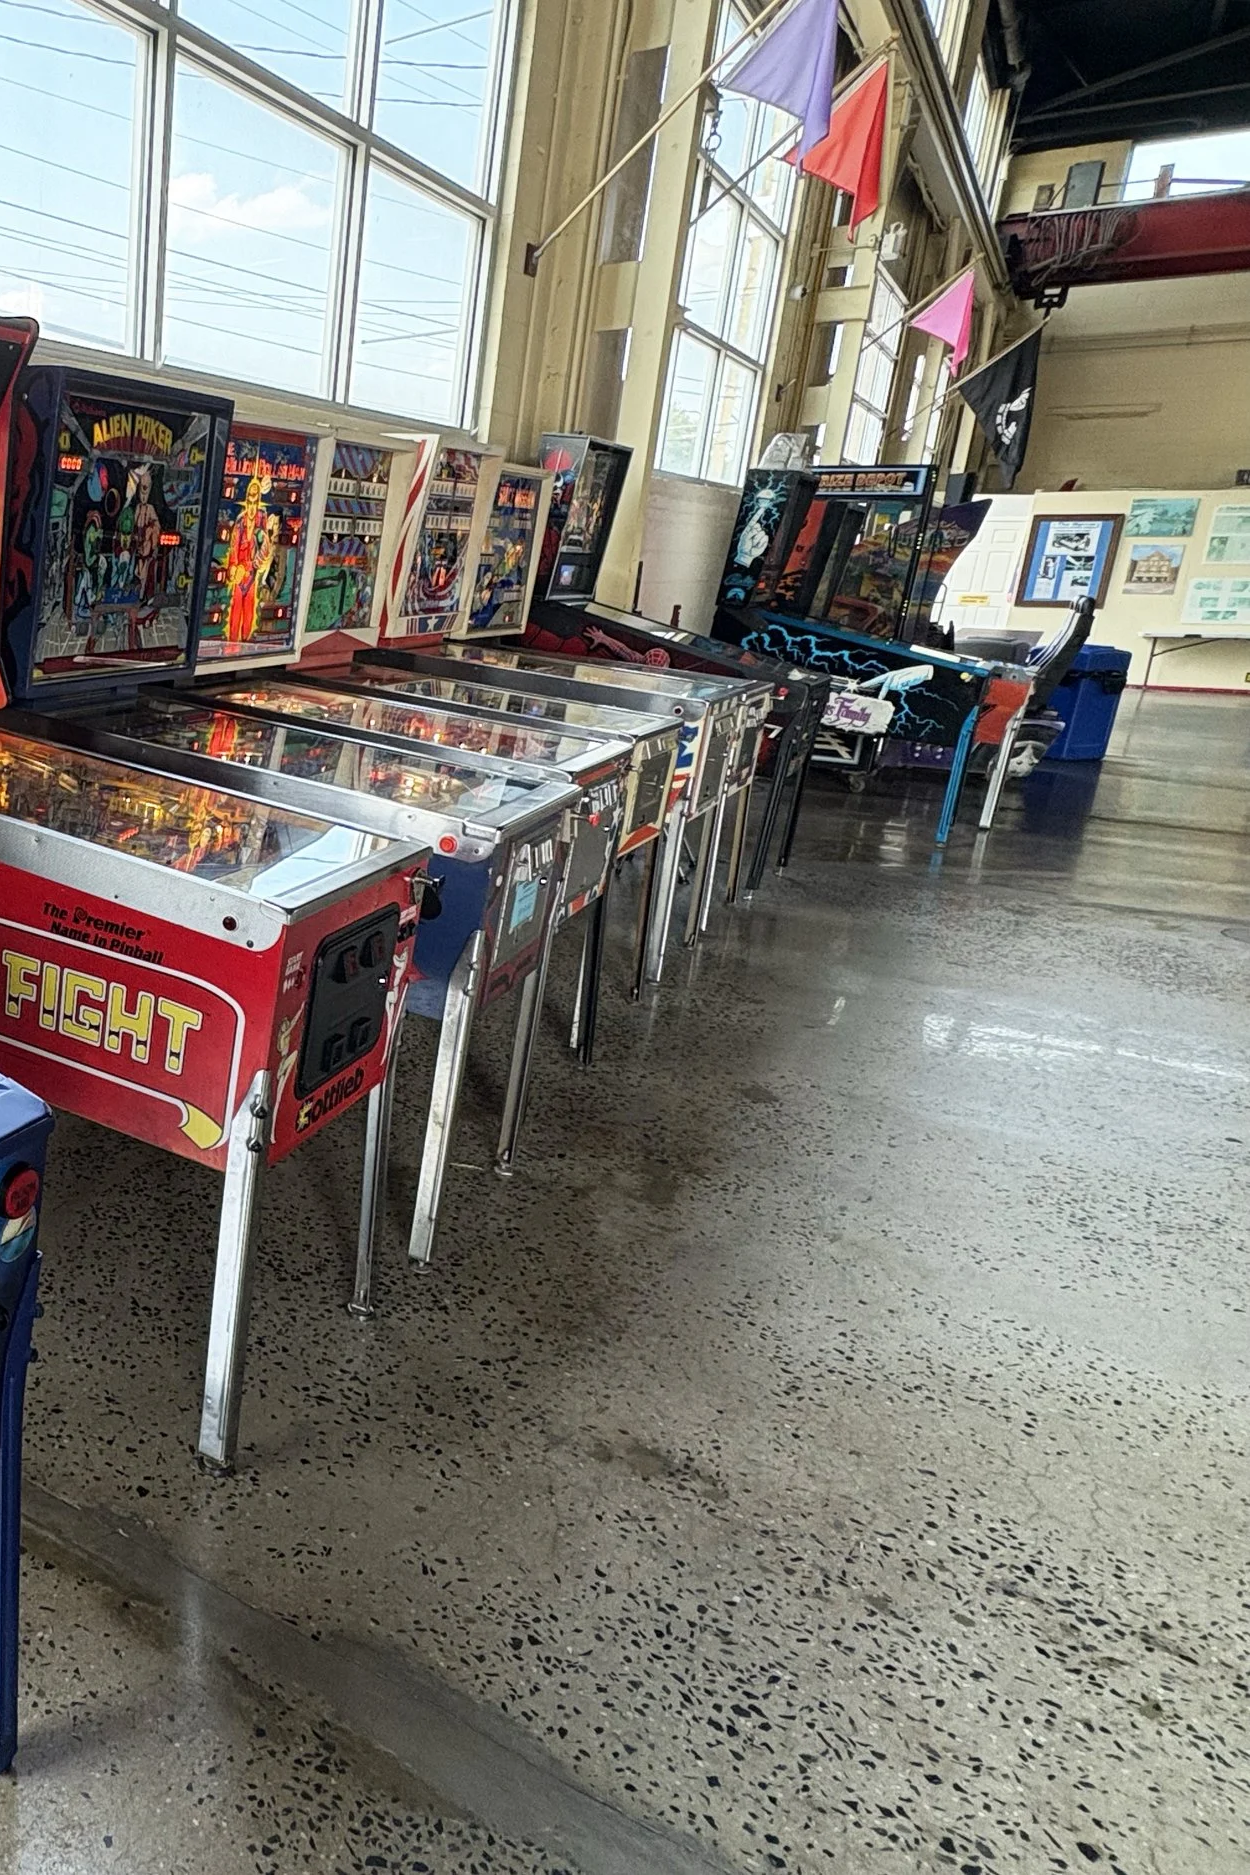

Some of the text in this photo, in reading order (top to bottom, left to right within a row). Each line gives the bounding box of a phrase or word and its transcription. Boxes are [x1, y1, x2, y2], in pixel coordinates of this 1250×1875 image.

[93, 413, 173, 455] ALIEN POKER
[818, 472, 908, 488] RIZE DEPOT
[834, 697, 872, 728] Family
[42, 901, 145, 940] The Premier
[51, 921, 91, 942] Name
[109, 938, 165, 965] Pinball
[3, 949, 204, 1076] FIGHT
[295, 1066, 365, 1134] Gottlieb
